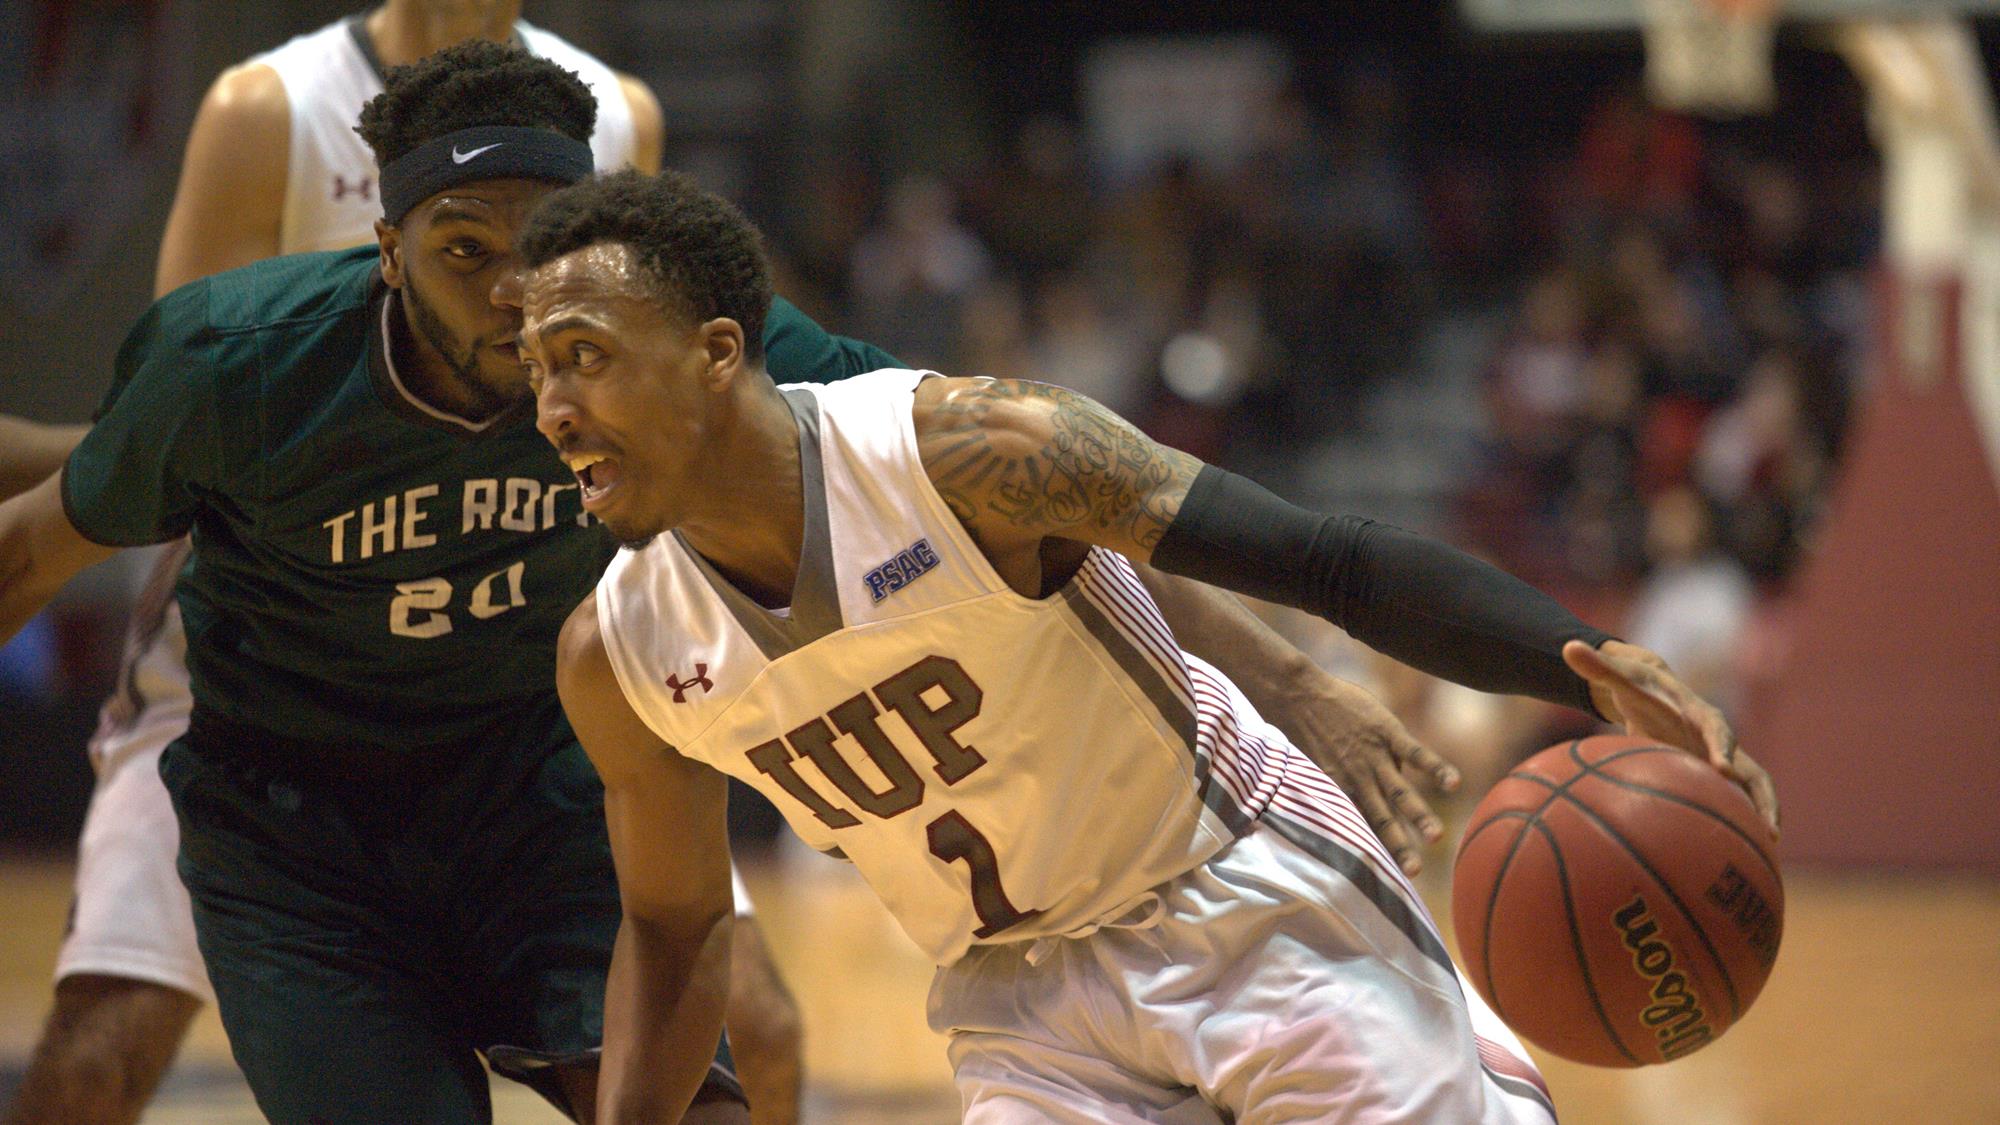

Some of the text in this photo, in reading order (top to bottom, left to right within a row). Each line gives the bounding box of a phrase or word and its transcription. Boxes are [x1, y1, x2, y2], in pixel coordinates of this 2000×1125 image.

[323, 477, 603, 563] THE ROC
[390, 561, 526, 638] 20
[863, 538, 941, 603] PSAC
[745, 654, 987, 830] IUP
[926, 808, 1038, 939] 1
